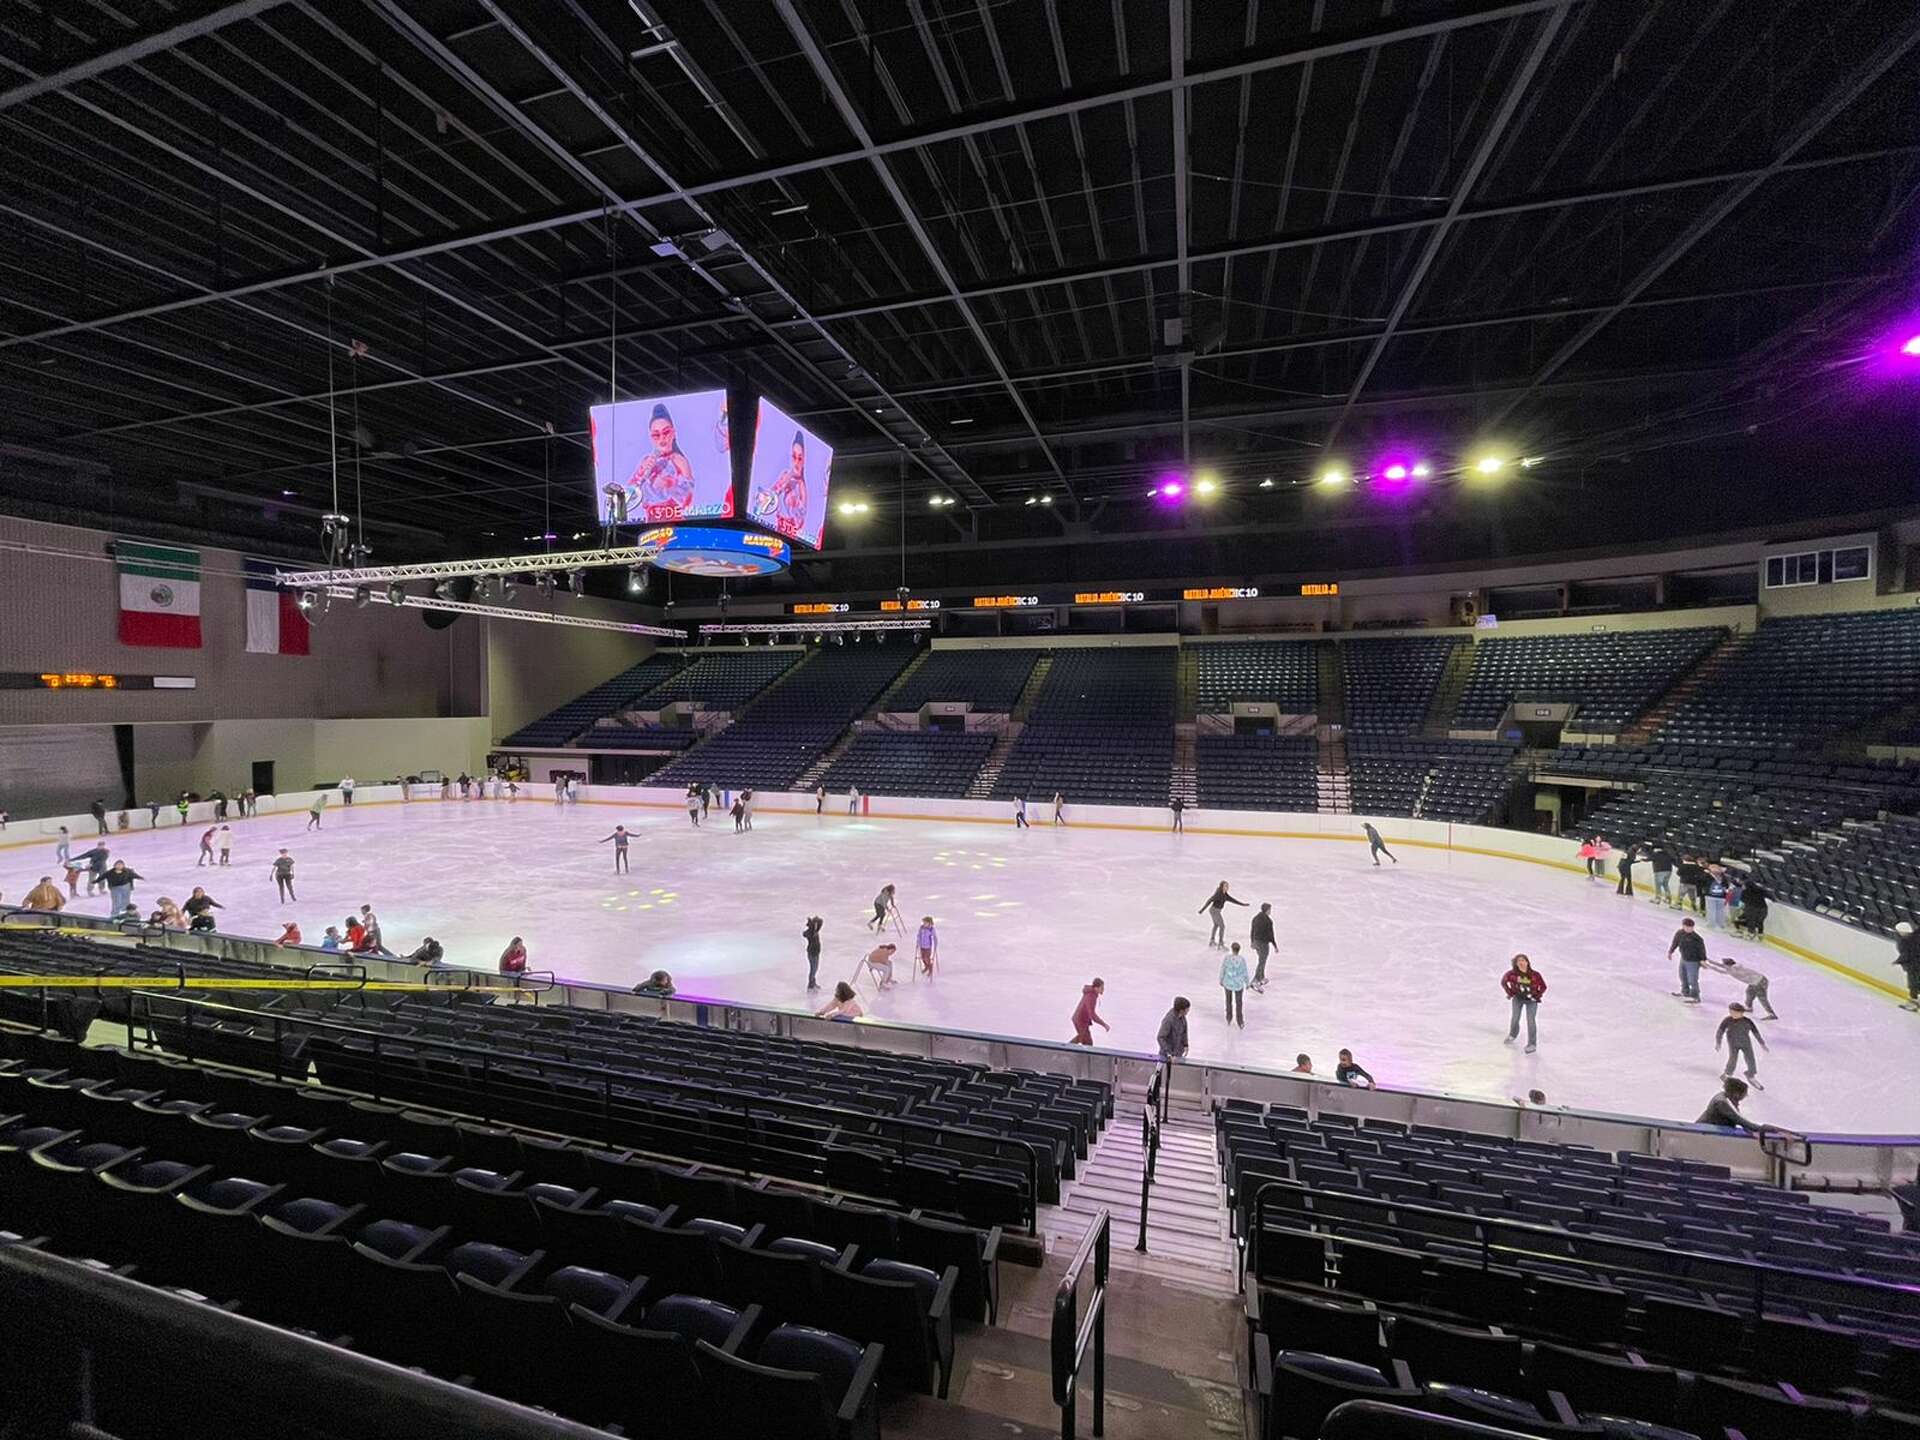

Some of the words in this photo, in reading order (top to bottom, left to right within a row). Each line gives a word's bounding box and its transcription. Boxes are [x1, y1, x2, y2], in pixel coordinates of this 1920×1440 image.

[1132, 592, 1144, 602] 10
[1246, 588, 1258, 597] 10
[930, 600, 941, 609] 10
[1028, 596, 1039, 605] 10
